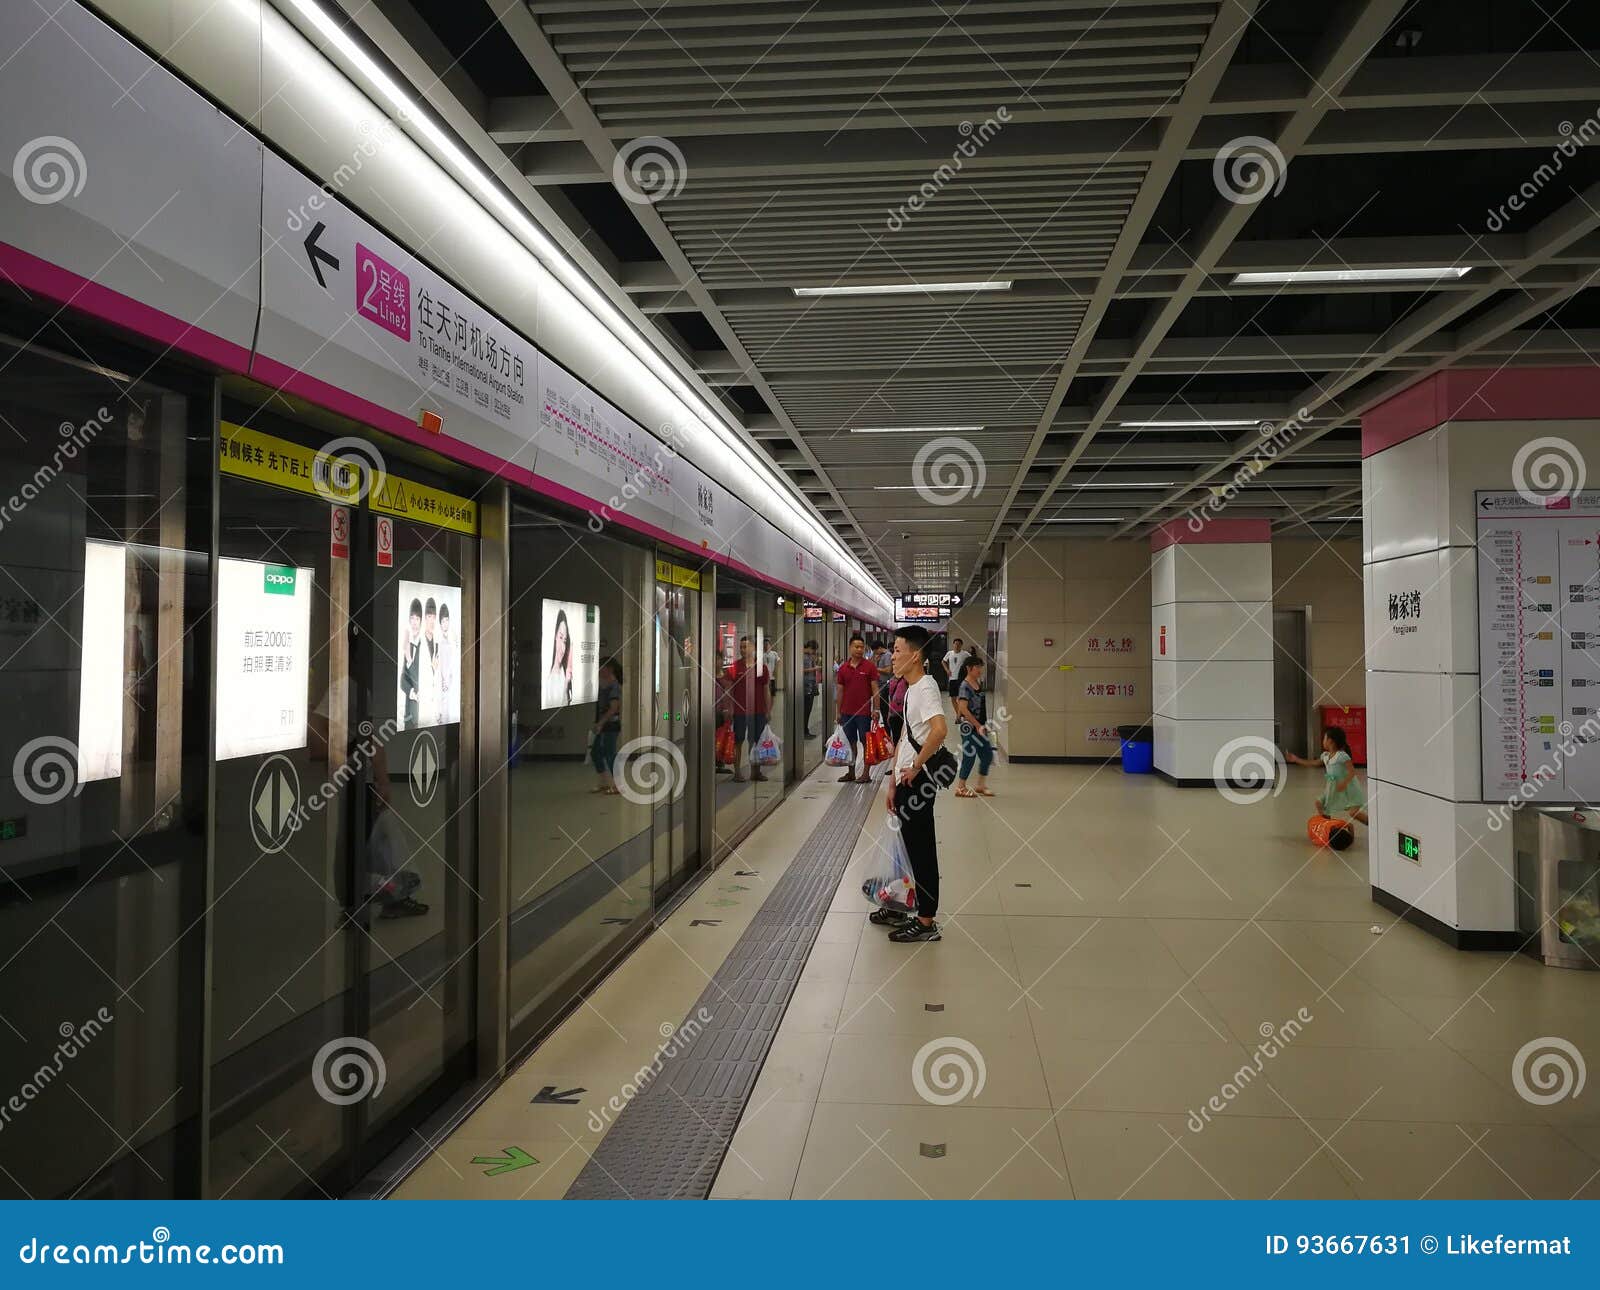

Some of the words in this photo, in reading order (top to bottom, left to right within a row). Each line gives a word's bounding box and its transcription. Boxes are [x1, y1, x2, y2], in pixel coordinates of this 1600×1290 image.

[362, 258, 406, 315] 2号线
[417, 287, 524, 387] 往天河机场方向
[418, 330, 428, 349] To
[428, 336, 451, 362] Tianhe
[220, 437, 264, 466] 两侧候车
[268, 451, 309, 478] 先下后上
[267, 574, 293, 585] oppo
[1389, 590, 1420, 620] 杨家湾
